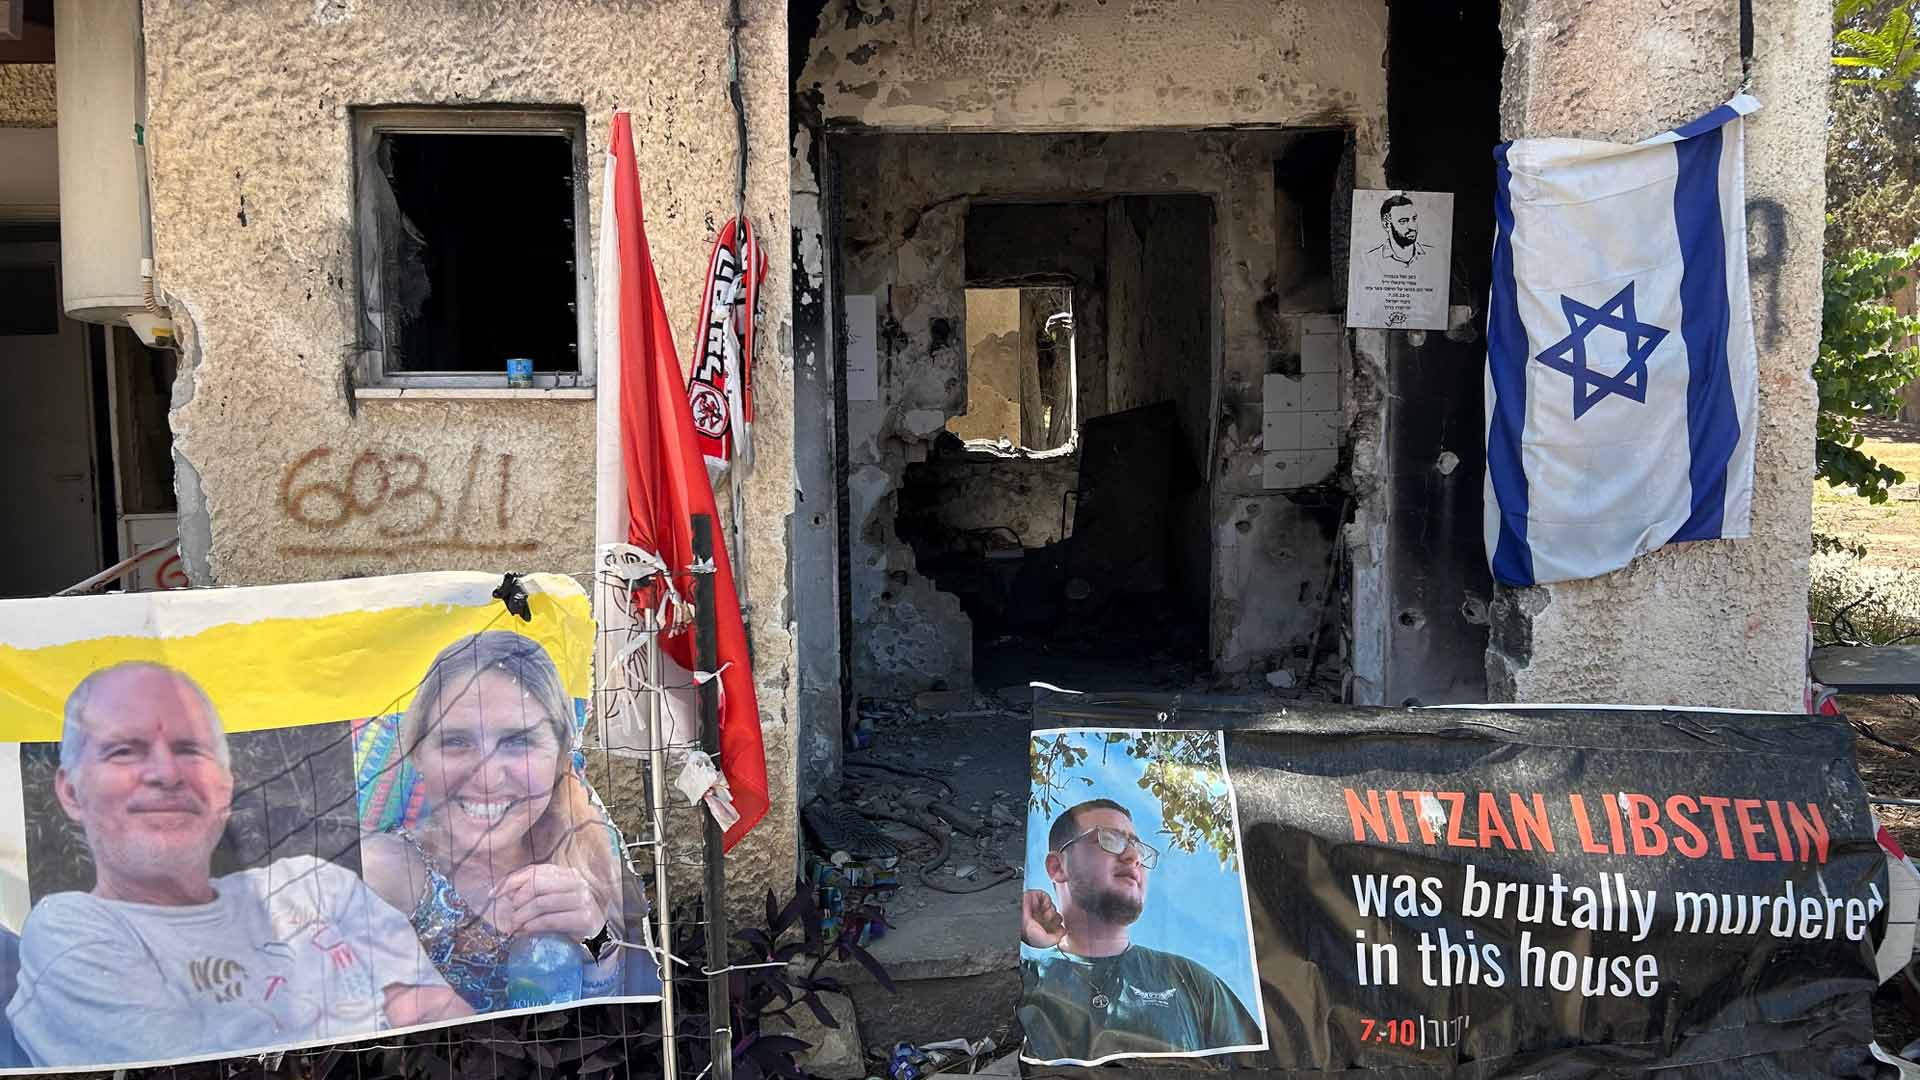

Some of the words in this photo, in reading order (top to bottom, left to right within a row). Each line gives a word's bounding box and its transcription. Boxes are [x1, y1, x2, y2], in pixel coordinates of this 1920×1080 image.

[1344, 789, 1555, 853] NITZAN
[1569, 794, 1830, 864] LIBSTEIN
[1352, 874, 1444, 919] was
[1462, 864, 1657, 941] brutally
[1355, 930, 1399, 987] in
[1417, 928, 1506, 988] this
[1519, 932, 1659, 998] house
